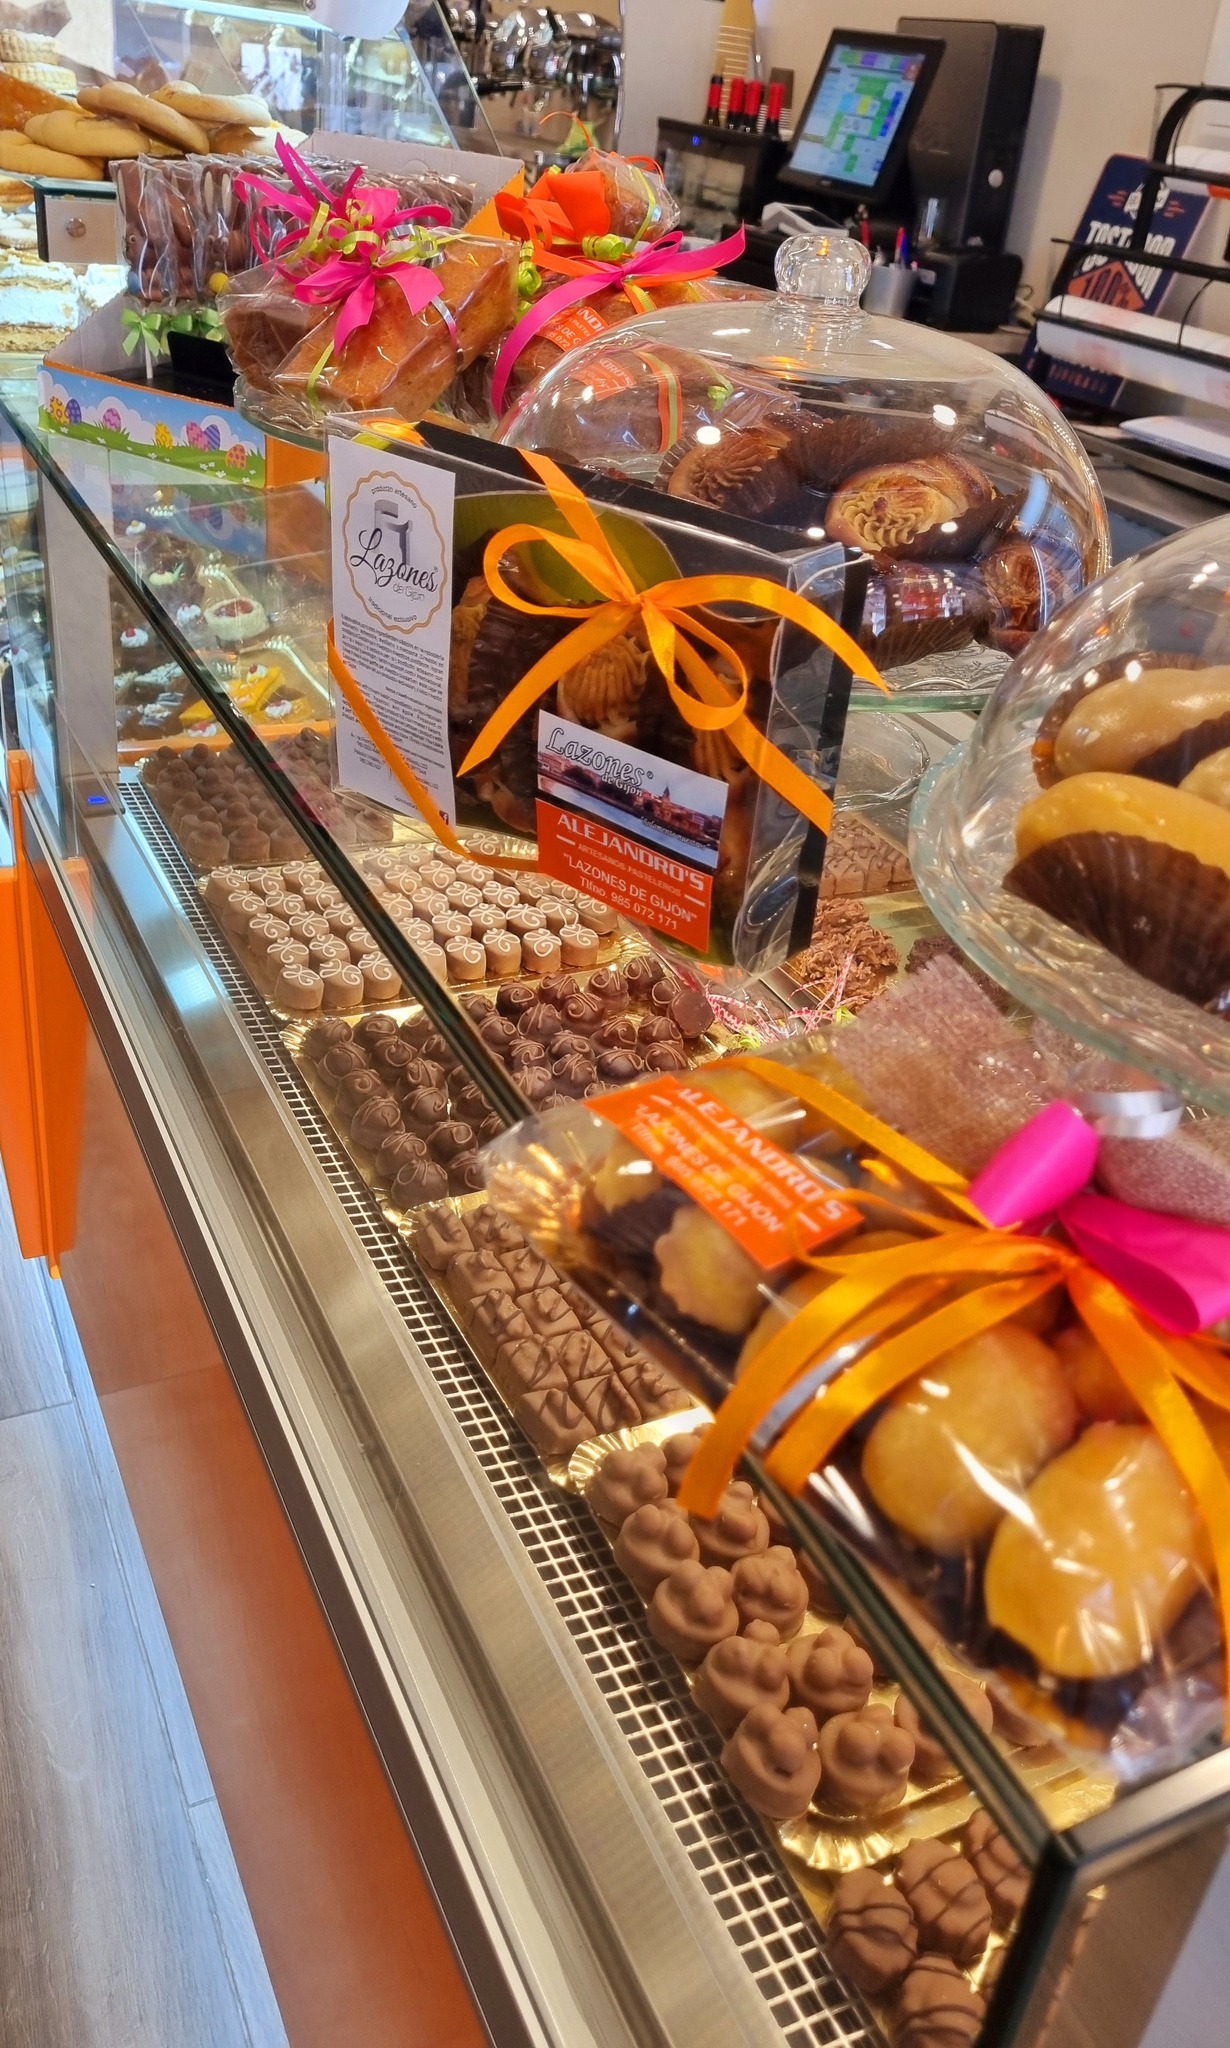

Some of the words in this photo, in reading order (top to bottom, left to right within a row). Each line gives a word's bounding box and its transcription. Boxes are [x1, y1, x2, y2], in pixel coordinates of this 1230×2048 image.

[350, 527, 439, 593] Lazones
[545, 727, 645, 787] Lazones
[601, 772, 614, 785] de
[557, 813, 704, 892] ALEJANDRO'S
[563, 852, 627, 893] "LAZONES
[629, 883, 647, 903] DE
[578, 844, 627, 871] ARTESANOS
[627, 866, 682, 897] PASTELEROS
[610, 891, 631, 909] 985
[633, 903, 654, 920] 072
[657, 914, 678, 930] 171
